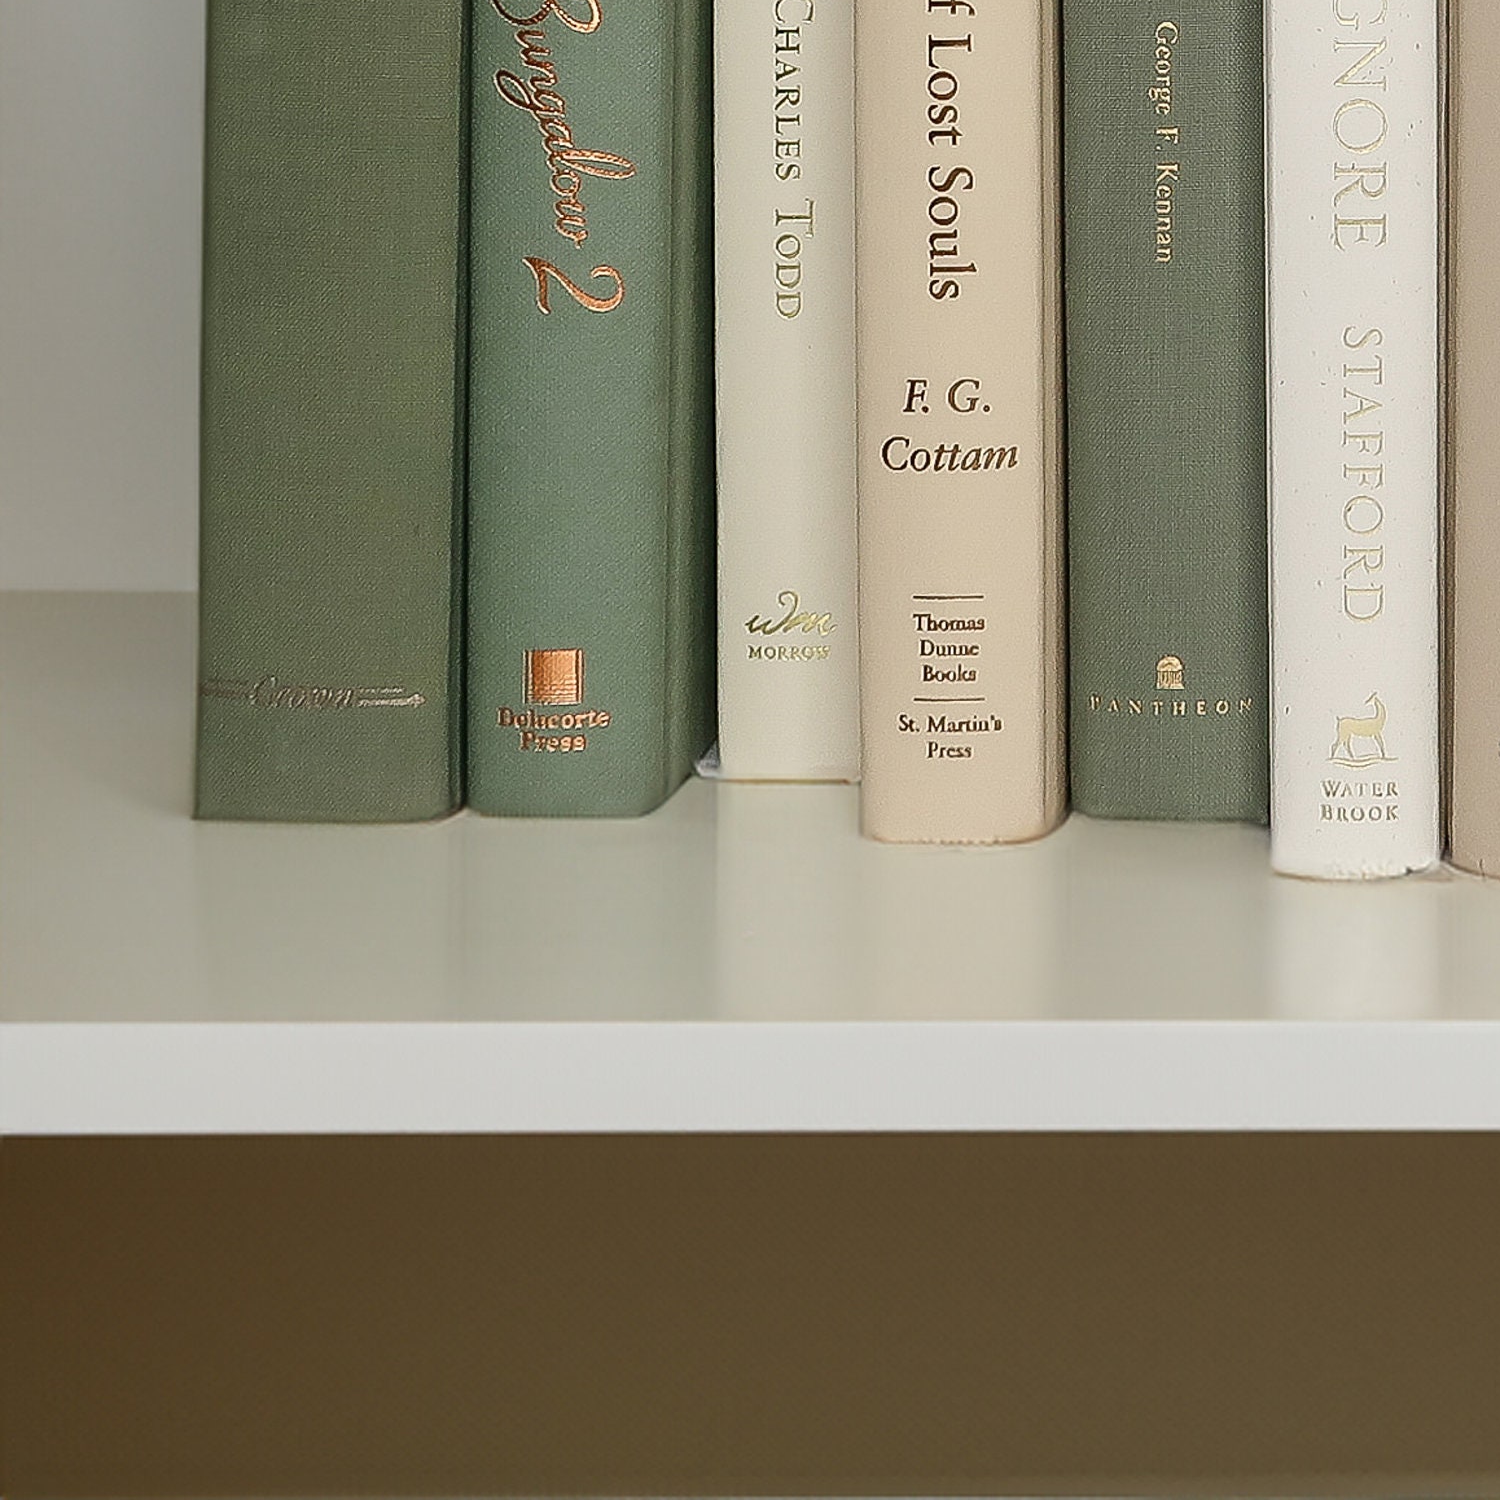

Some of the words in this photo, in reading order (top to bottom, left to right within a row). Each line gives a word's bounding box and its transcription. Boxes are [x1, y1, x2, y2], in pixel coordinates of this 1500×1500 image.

[1148, 20, 1180, 116] George
[926, 33, 972, 147] Lost
[1155, 126, 1180, 152] F.
[1155, 161, 1180, 263] Kennan
[927, 165, 977, 301] Souls
[774, 198, 815, 320] TODD
[523, 257, 626, 315] 2
[902, 377, 930, 415] F.
[946, 377, 992, 415] G.
[880, 435, 1019, 474] Cottam
[1342, 325, 1386, 621] STAFFORD
[912, 613, 985, 632] Thomas
[748, 644, 831, 661] MORROW
[919, 639, 980, 657] Dunne
[922, 664, 977, 683] Books
[1088, 695, 1253, 716] PANTHEON
[497, 706, 612, 730] Delacorte
[899, 713, 920, 733] St.
[926, 714, 1002, 733] Martin's
[518, 730, 587, 753] Press
[926, 741, 973, 759] Press
[1320, 779, 1400, 799] WATER
[1319, 803, 1400, 822] BROOK
